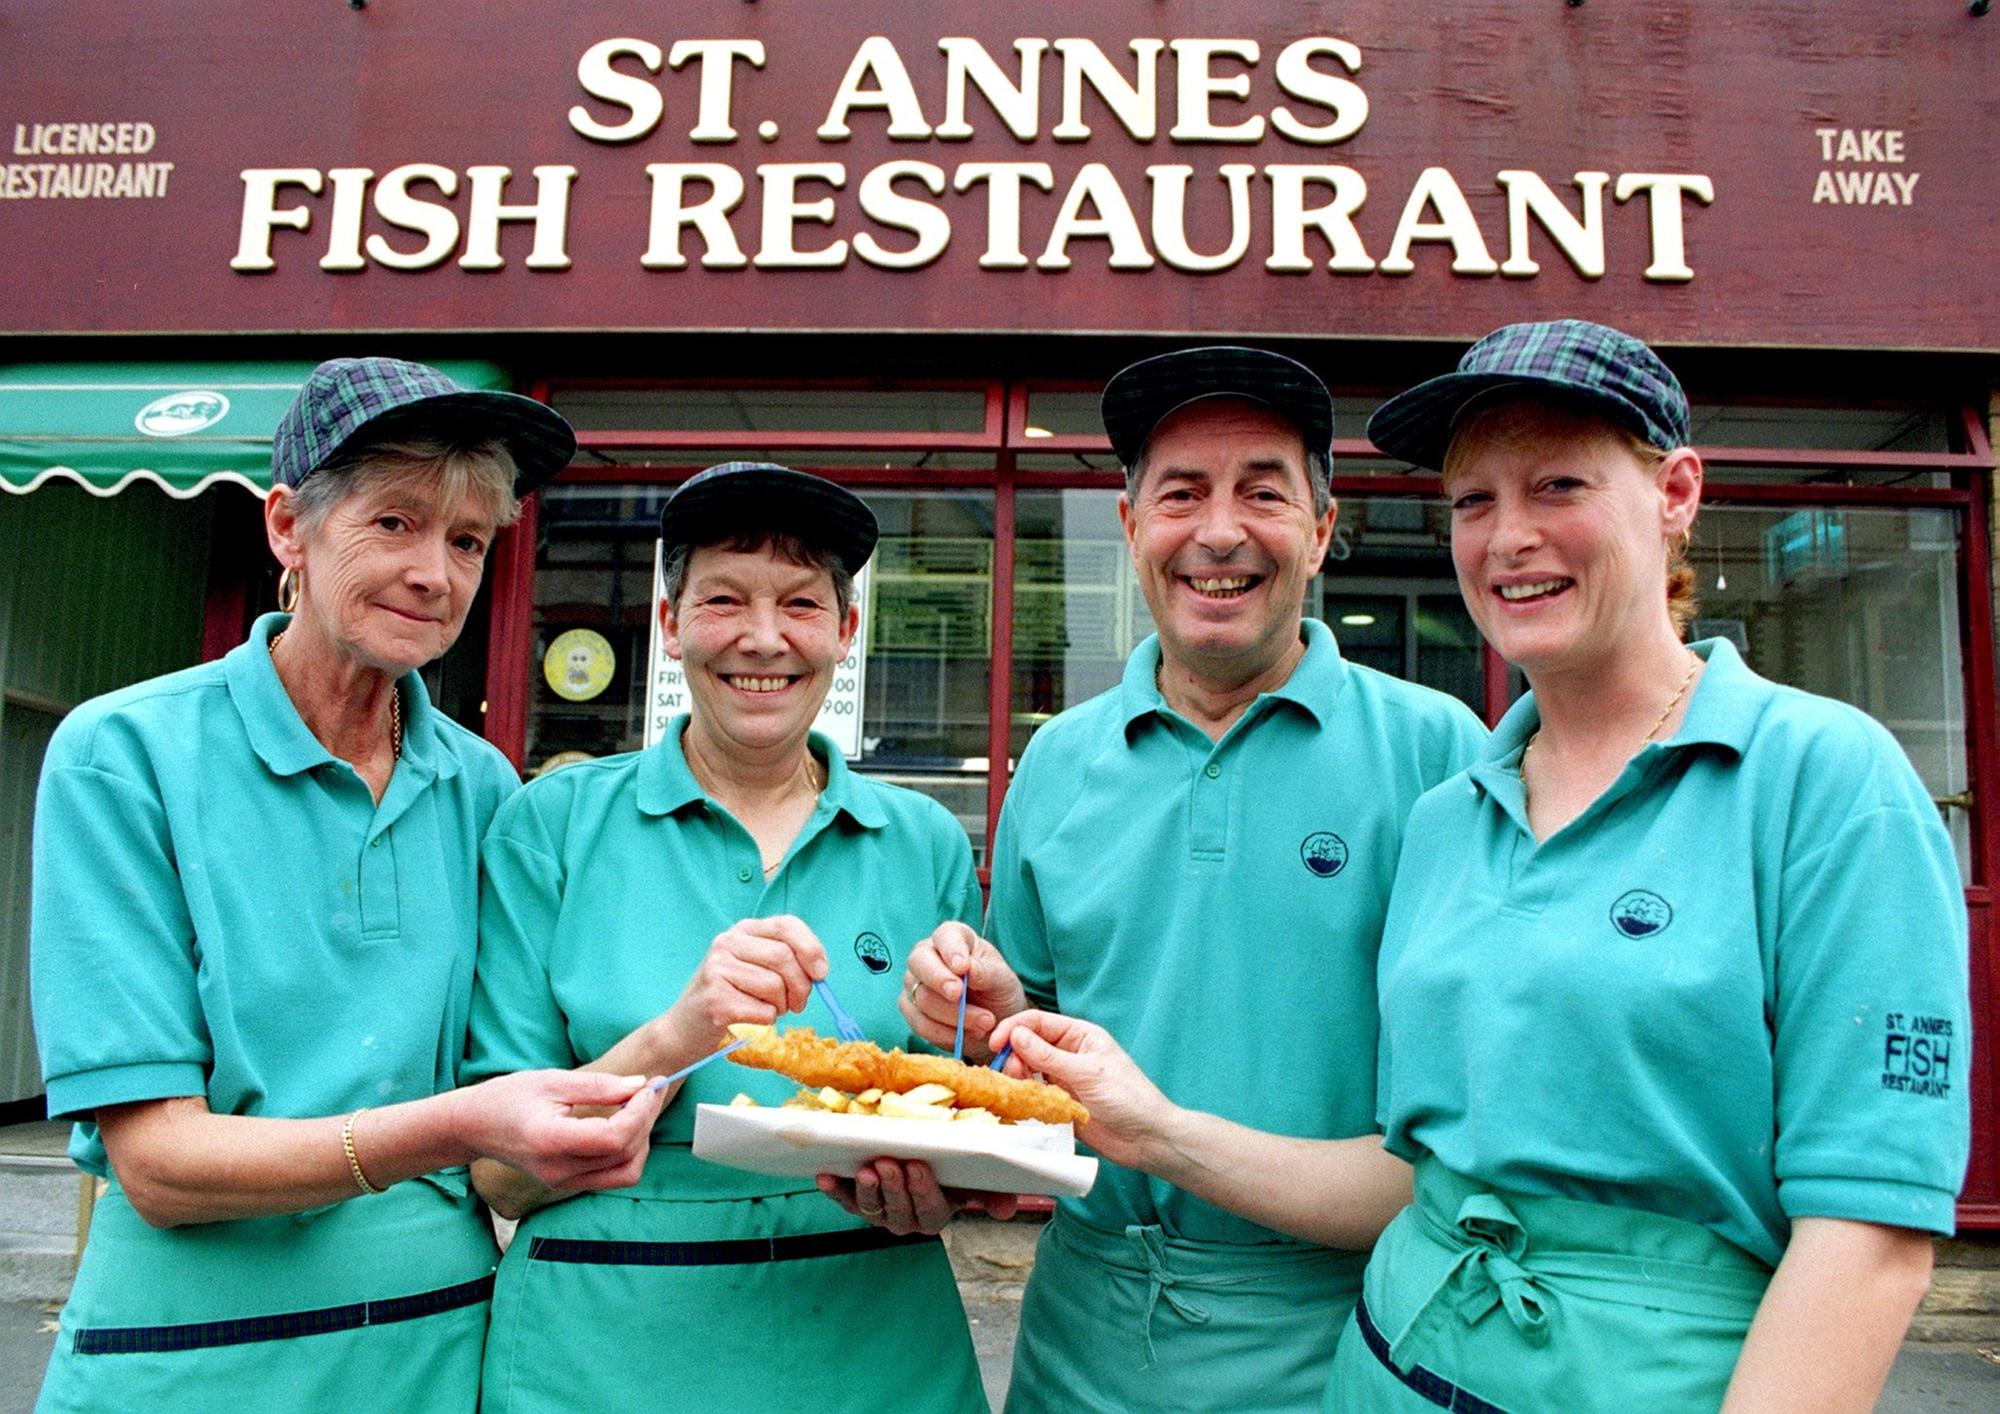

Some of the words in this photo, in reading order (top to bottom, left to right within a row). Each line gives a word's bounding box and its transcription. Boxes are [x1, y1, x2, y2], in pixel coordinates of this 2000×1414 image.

[568, 36, 779, 143] ST.
[816, 35, 1370, 145] ANNES
[13, 121, 157, 156] LICENSED
[1814, 128, 1906, 164] TAKE
[1812, 169, 1921, 206] AWAY
[229, 162, 580, 273] FISH
[640, 159, 1715, 283] RESTAURANT
[658, 671, 682, 684] FRI
[657, 693, 684, 707] SAT
[1910, 1016, 1953, 1037] ANNES
[1884, 1033, 1951, 1081] FISH
[1881, 1072, 1951, 1099] RESTAURANT
